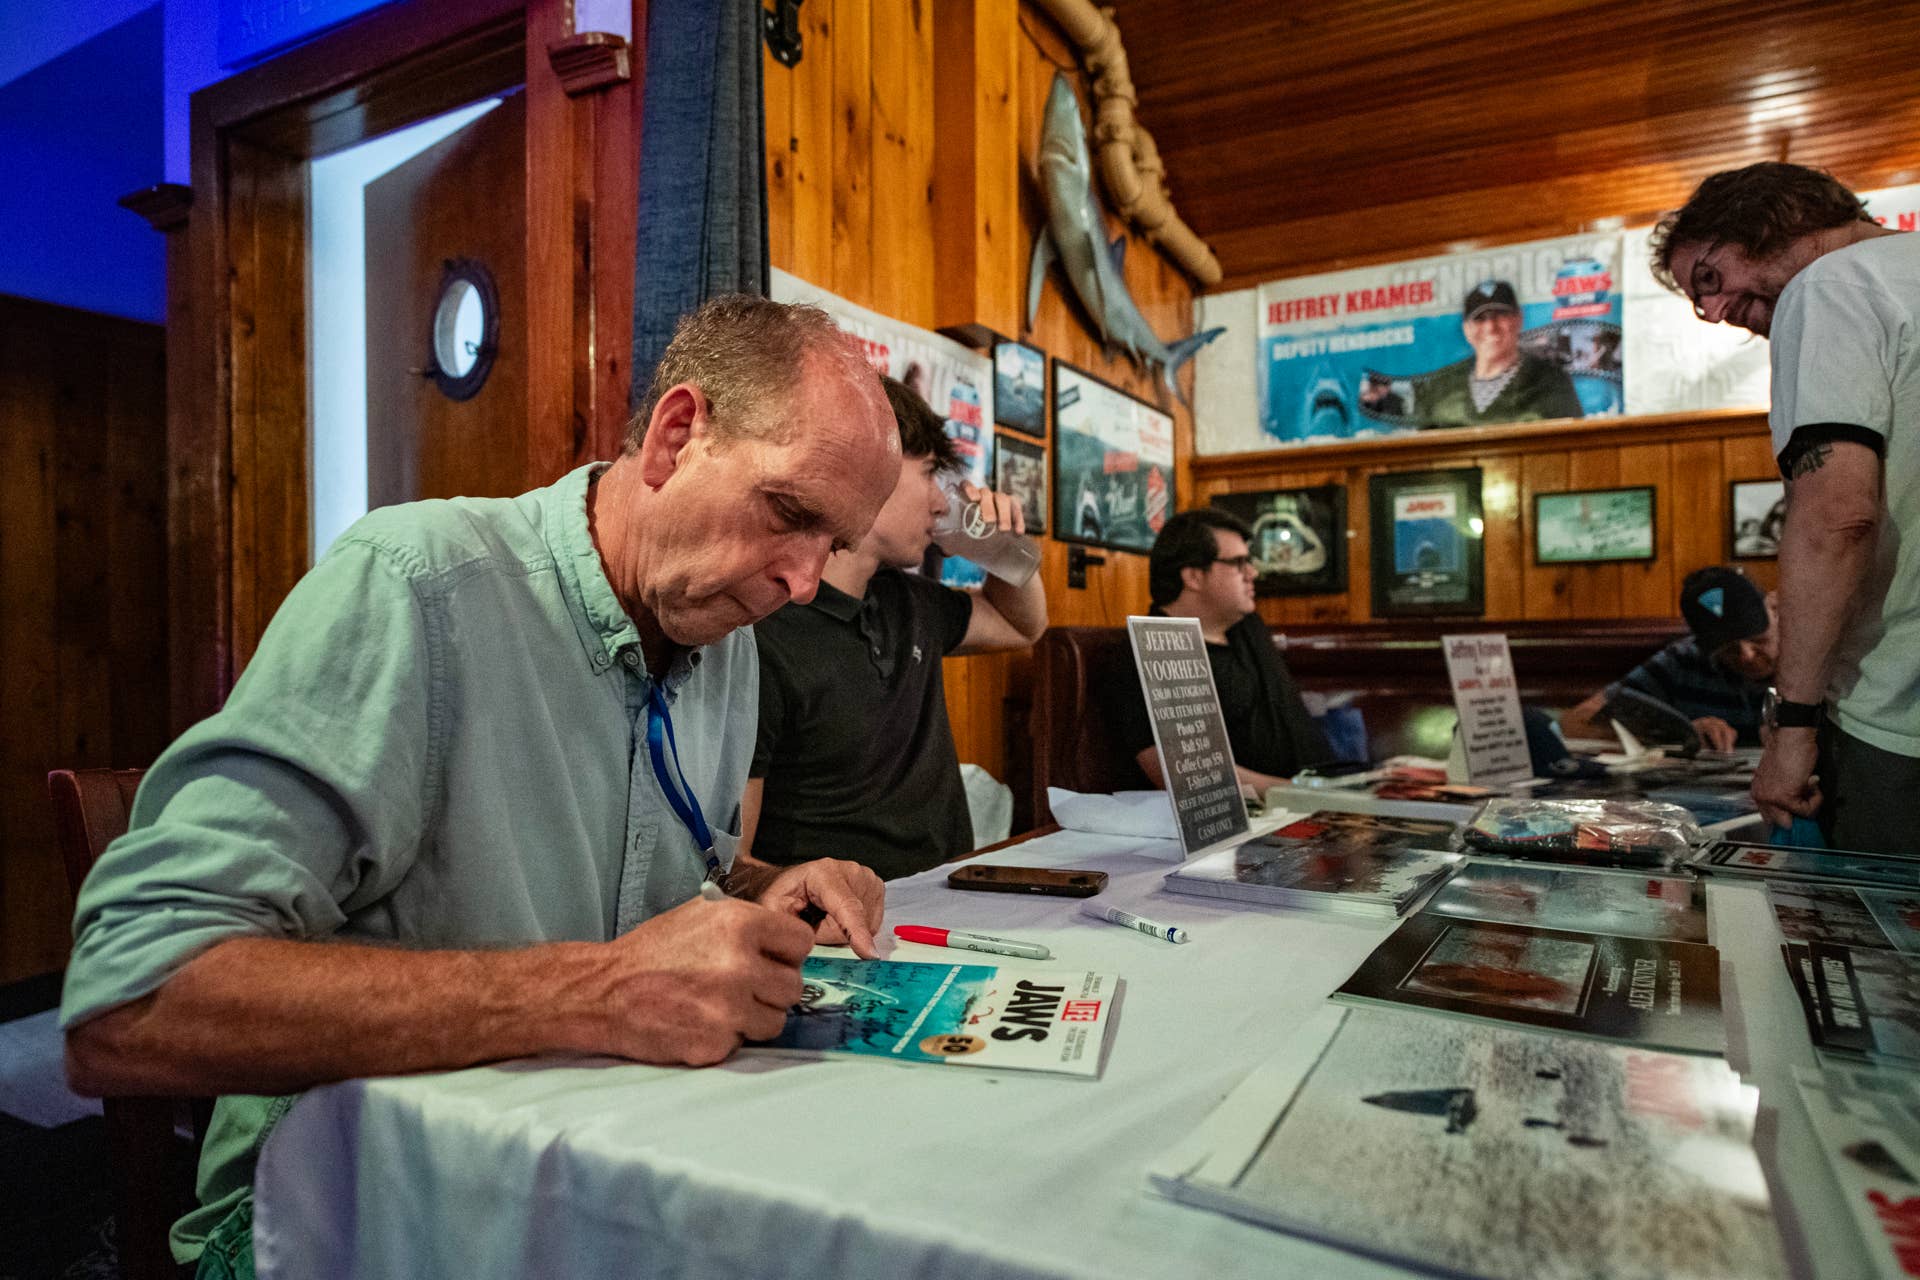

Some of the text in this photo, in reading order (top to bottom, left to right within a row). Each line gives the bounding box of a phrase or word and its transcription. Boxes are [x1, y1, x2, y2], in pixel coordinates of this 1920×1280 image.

[1552, 272, 1612, 296] JAWS
[1268, 281, 1433, 325] JEFFREY KRAMER
[1272, 325, 1415, 361] DEPUTY HENDRICKS
[1144, 630, 1193, 652] JEFFREY
[1143, 659, 1209, 682] VOORHEES
[1172, 684, 1212, 699] AUTOGRAPH
[1154, 706, 1175, 721] YOUR
[1176, 704, 1194, 719] ITEM
[1175, 758, 1197, 775] Coffee
[1197, 754, 1212, 771] Cups
[1186, 773, 1211, 791] T-Shirts
[1198, 816, 1233, 840] CASH ONLY
[1628, 958, 1657, 1011] ALEX KINTNER
[991, 979, 1065, 1043] JAWS
[1061, 1000, 1102, 1022] LIFE
[942, 1036, 974, 1054] 50
